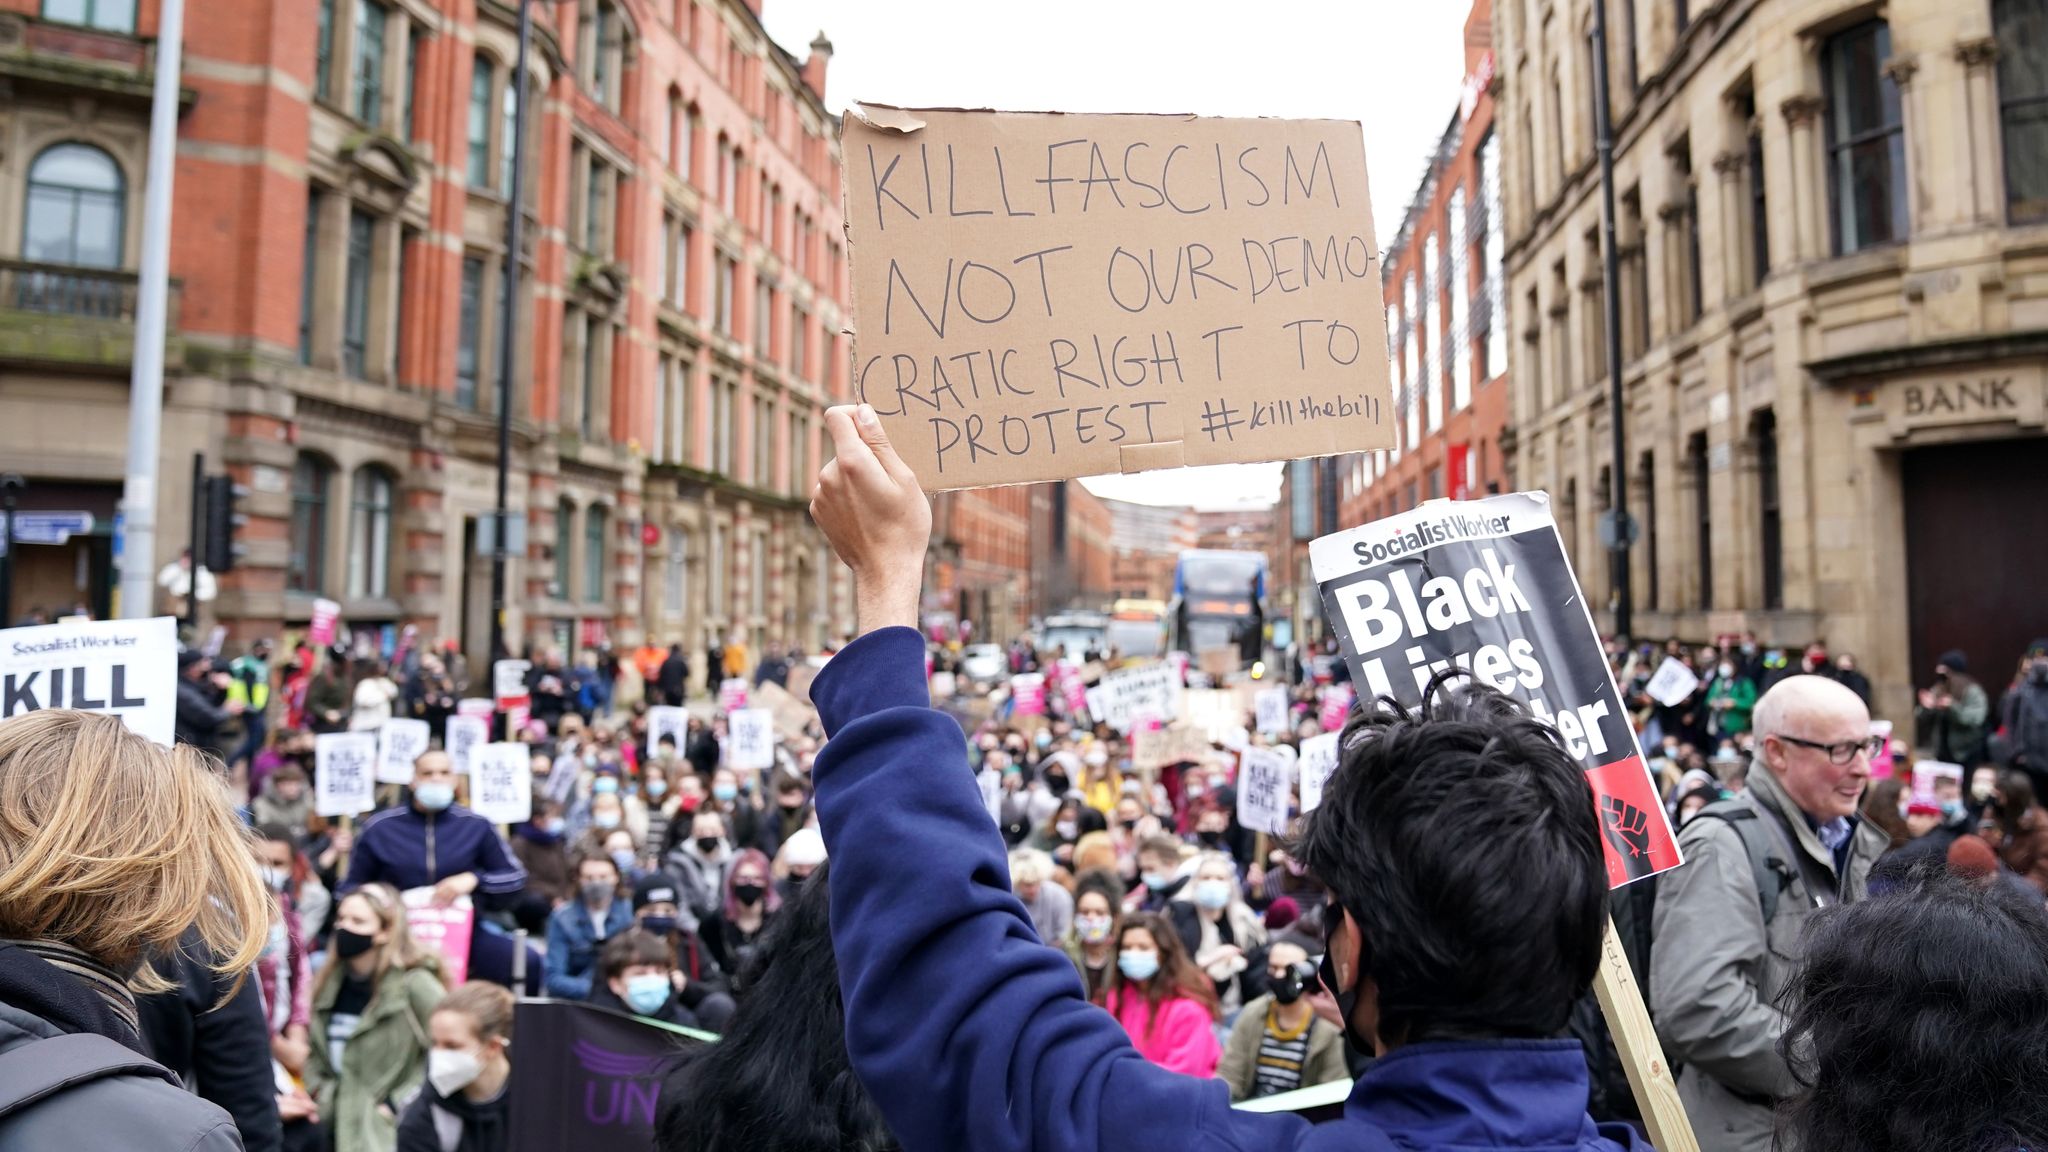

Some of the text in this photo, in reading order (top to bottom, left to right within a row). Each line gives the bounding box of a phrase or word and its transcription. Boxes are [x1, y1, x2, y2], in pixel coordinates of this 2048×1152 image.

[867, 139, 1341, 231] KILL FASCISM
[885, 235, 1377, 339] NOT OUR DEMO-
[860, 348, 1035, 416] CRATIC
[1282, 319, 1361, 371] TO
[1904, 377, 2017, 418] BANK
[928, 400, 1168, 473] PROTEST
[1353, 513, 1511, 566] Socialist Worker
[1334, 547, 1532, 656] Black
[12, 634, 138, 656] Socialist Worker
[3, 663, 145, 718] KILL
